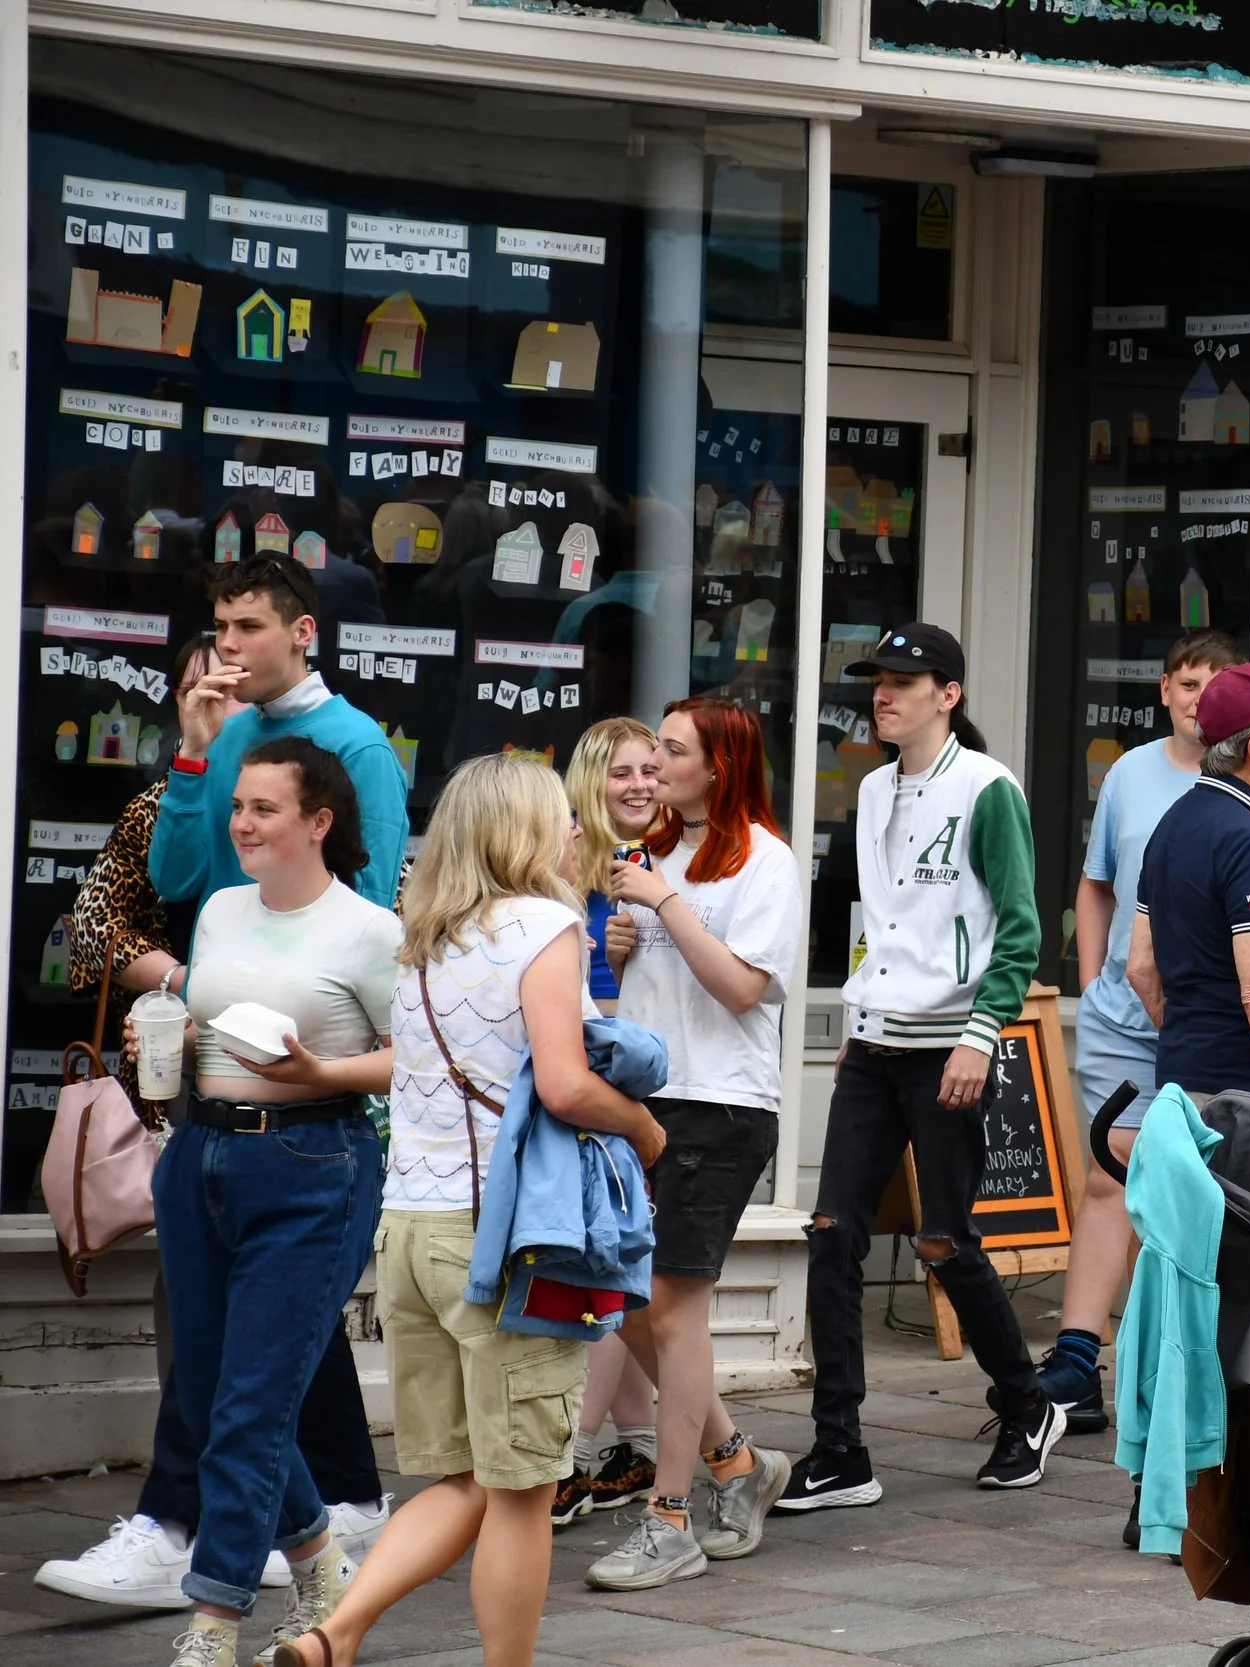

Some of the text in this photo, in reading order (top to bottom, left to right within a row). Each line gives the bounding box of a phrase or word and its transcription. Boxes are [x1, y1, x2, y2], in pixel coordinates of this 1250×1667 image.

[69, 220, 171, 251] GRAND
[234, 239, 293, 265] FUN
[350, 246, 467, 275] WELCOMING
[513, 263, 548, 277] KIND
[87, 425, 160, 449] COOL
[831, 427, 899, 446] CARE
[353, 451, 460, 476] FAMILY
[227, 464, 312, 493] SHARE
[491, 484, 565, 506] FUNNY
[46, 650, 164, 700] SUPPORTIVE
[346, 655, 412, 677] QUIET
[481, 686, 578, 708] SWEET
[917, 816, 962, 865] A
[1001, 1113, 1018, 1146] by
